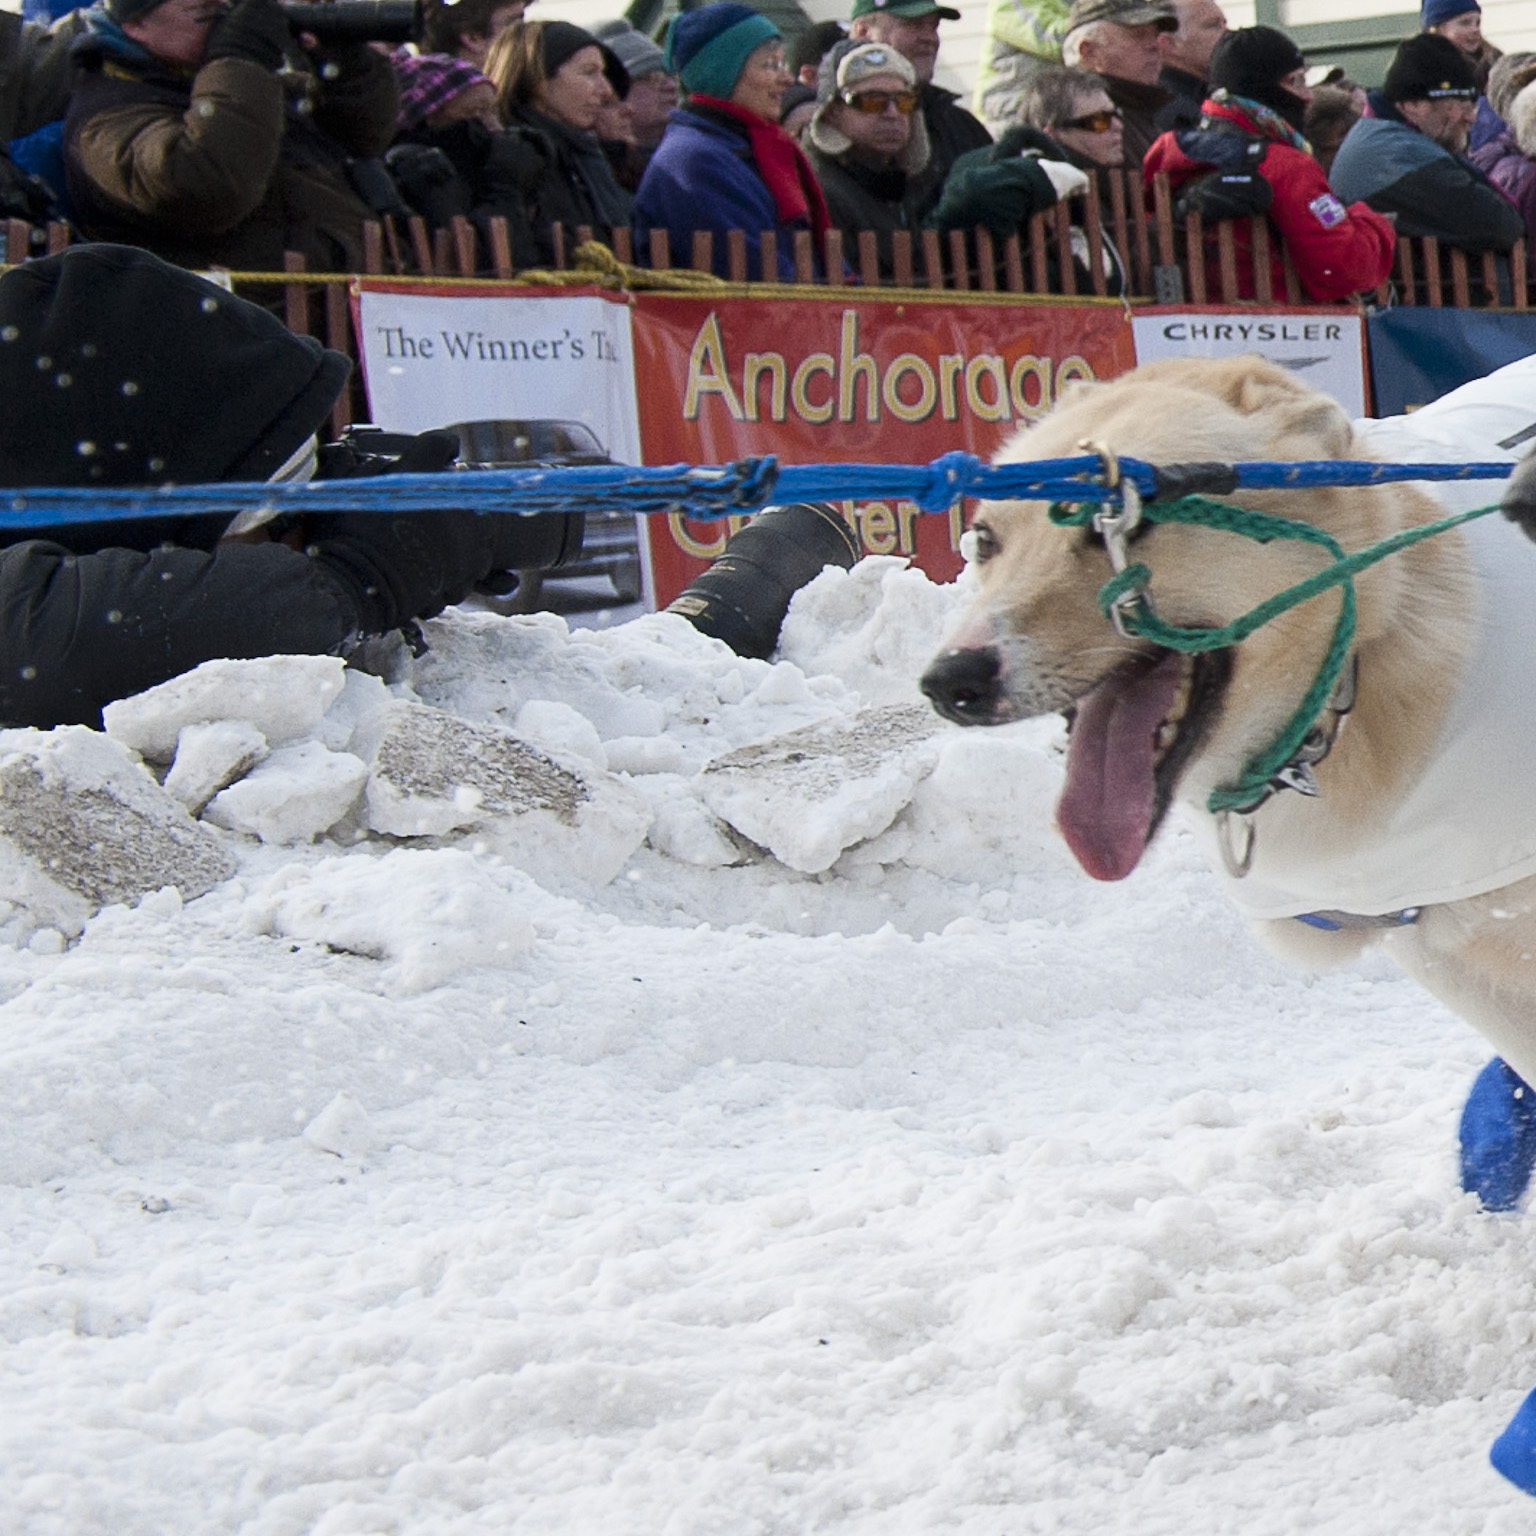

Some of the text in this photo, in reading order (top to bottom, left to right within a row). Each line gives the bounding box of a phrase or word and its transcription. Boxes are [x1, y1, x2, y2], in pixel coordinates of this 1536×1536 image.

[378, 327, 433, 359] The
[441, 328, 584, 361] Winner's
[1164, 324, 1341, 340] CHRYSLER
